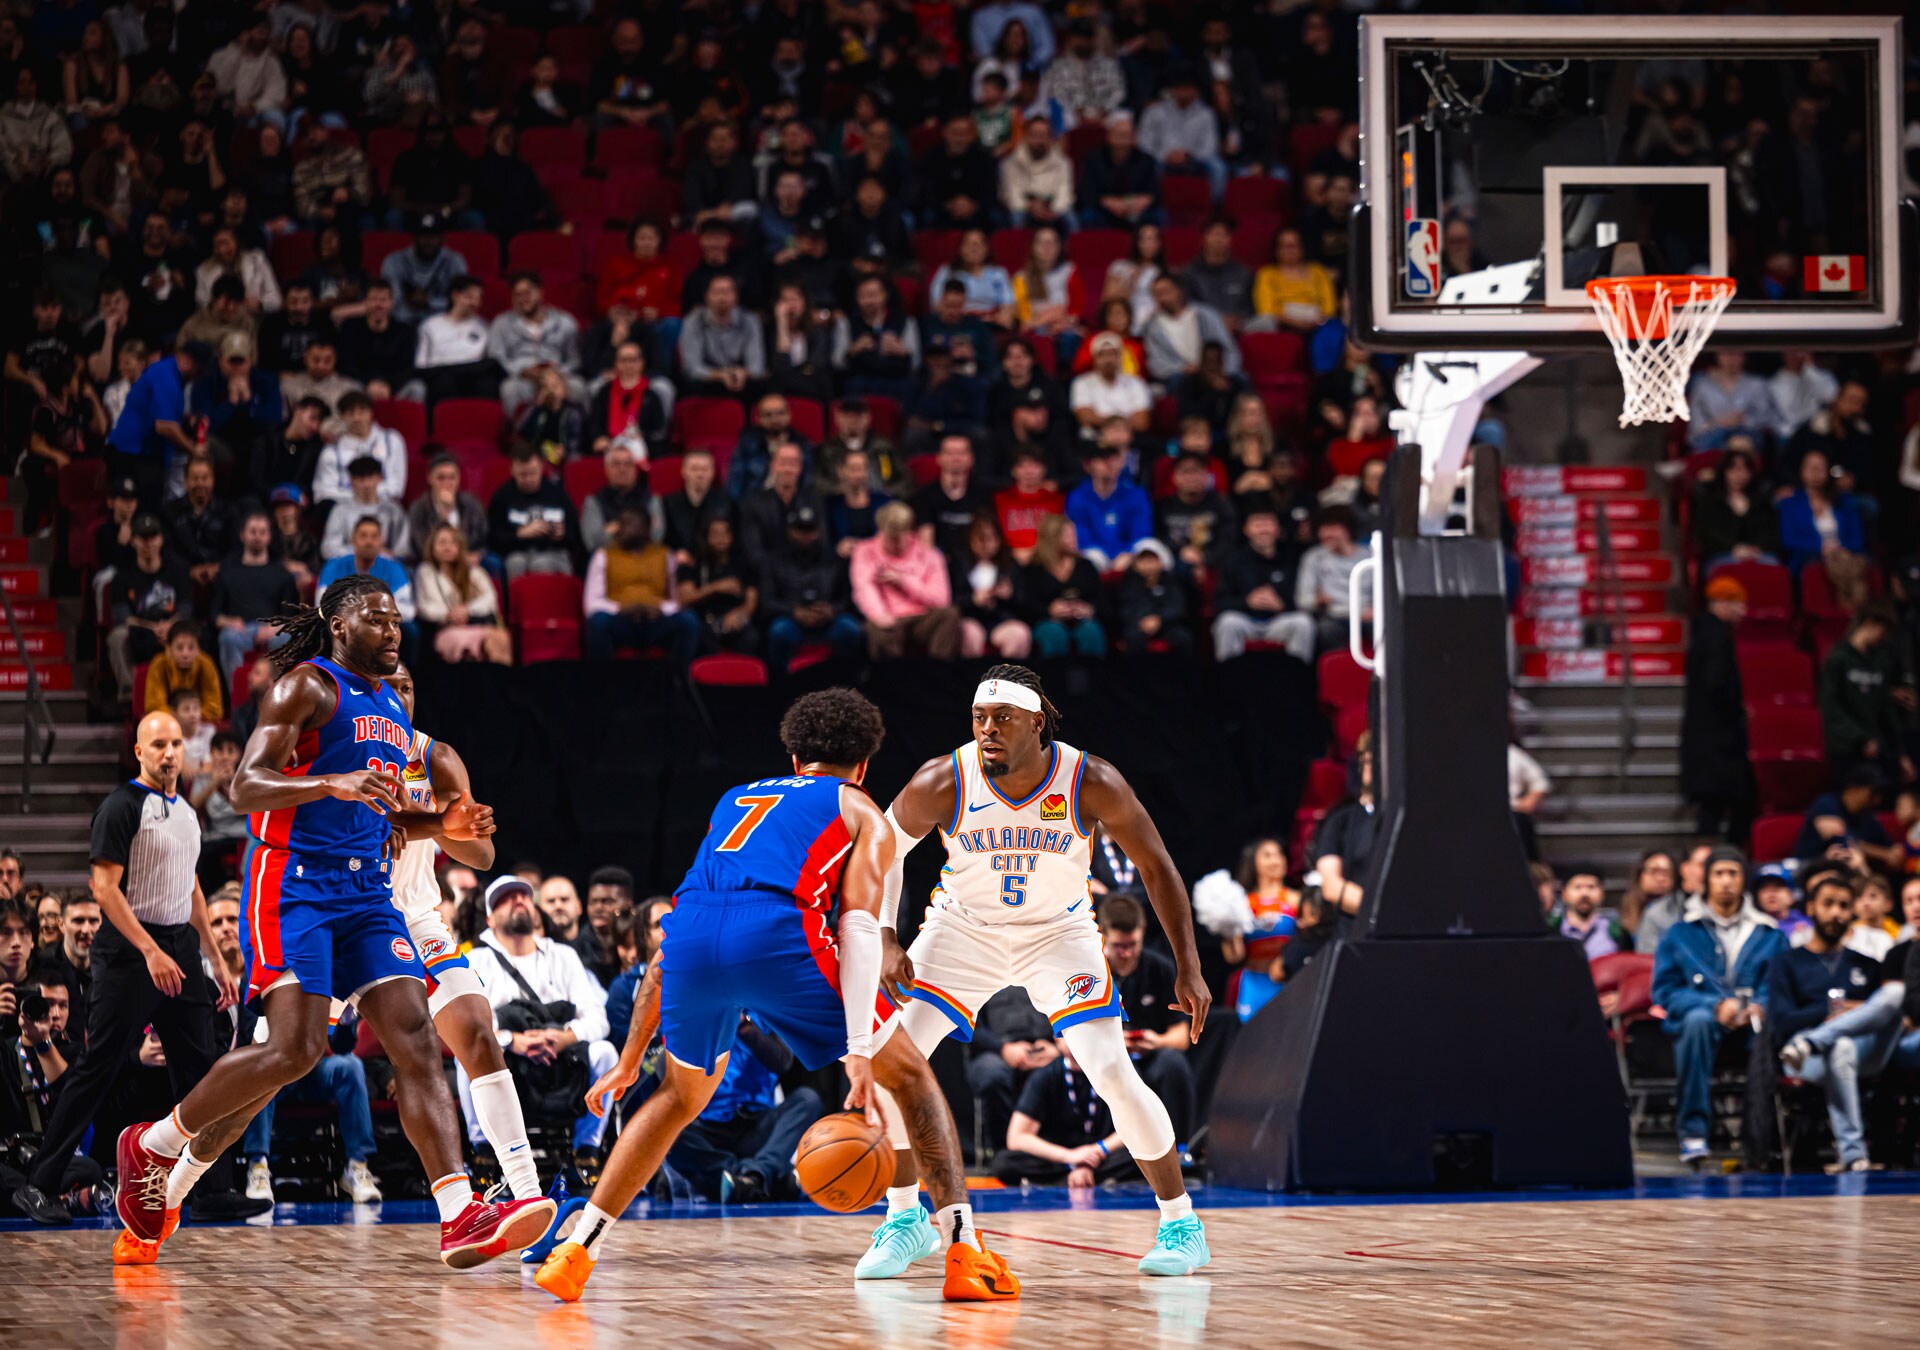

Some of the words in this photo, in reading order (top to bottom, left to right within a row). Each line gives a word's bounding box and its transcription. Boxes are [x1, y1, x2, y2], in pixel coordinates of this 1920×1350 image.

[714, 794, 785, 852] 7
[957, 826, 1075, 855] OKLAHOMA
[990, 853, 1040, 873] CITY
[999, 873, 1028, 908] 5
